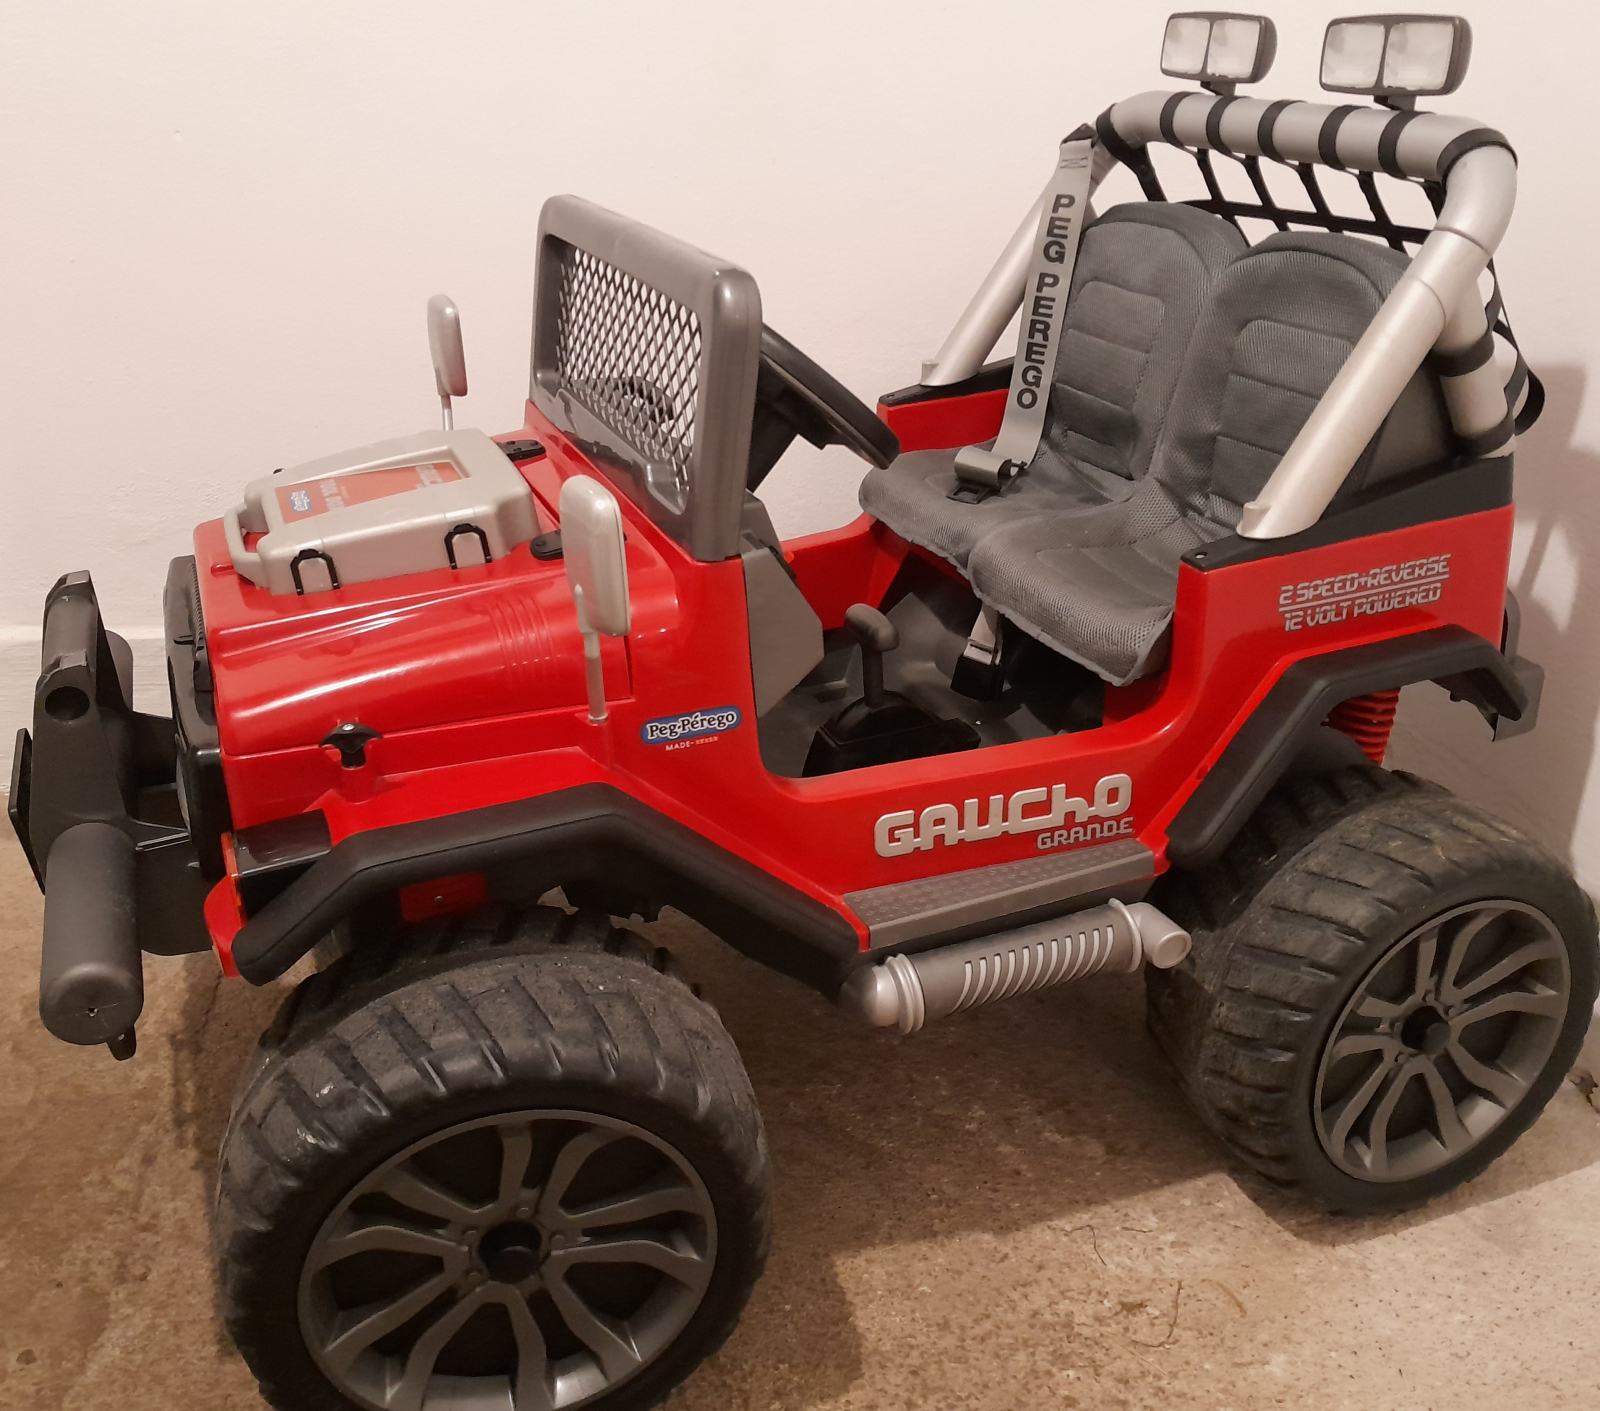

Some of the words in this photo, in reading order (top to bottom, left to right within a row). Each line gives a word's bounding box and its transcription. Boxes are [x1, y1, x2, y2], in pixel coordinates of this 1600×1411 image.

[1043, 194, 1076, 265] PEG
[1017, 272, 1060, 409] PEREGO
[1279, 585, 1294, 605] 2
[1285, 611, 1304, 631] 12
[1306, 602, 1348, 626] VOLT
[1353, 582, 1442, 618] POWERED
[1037, 817, 1134, 849] GRANDE
